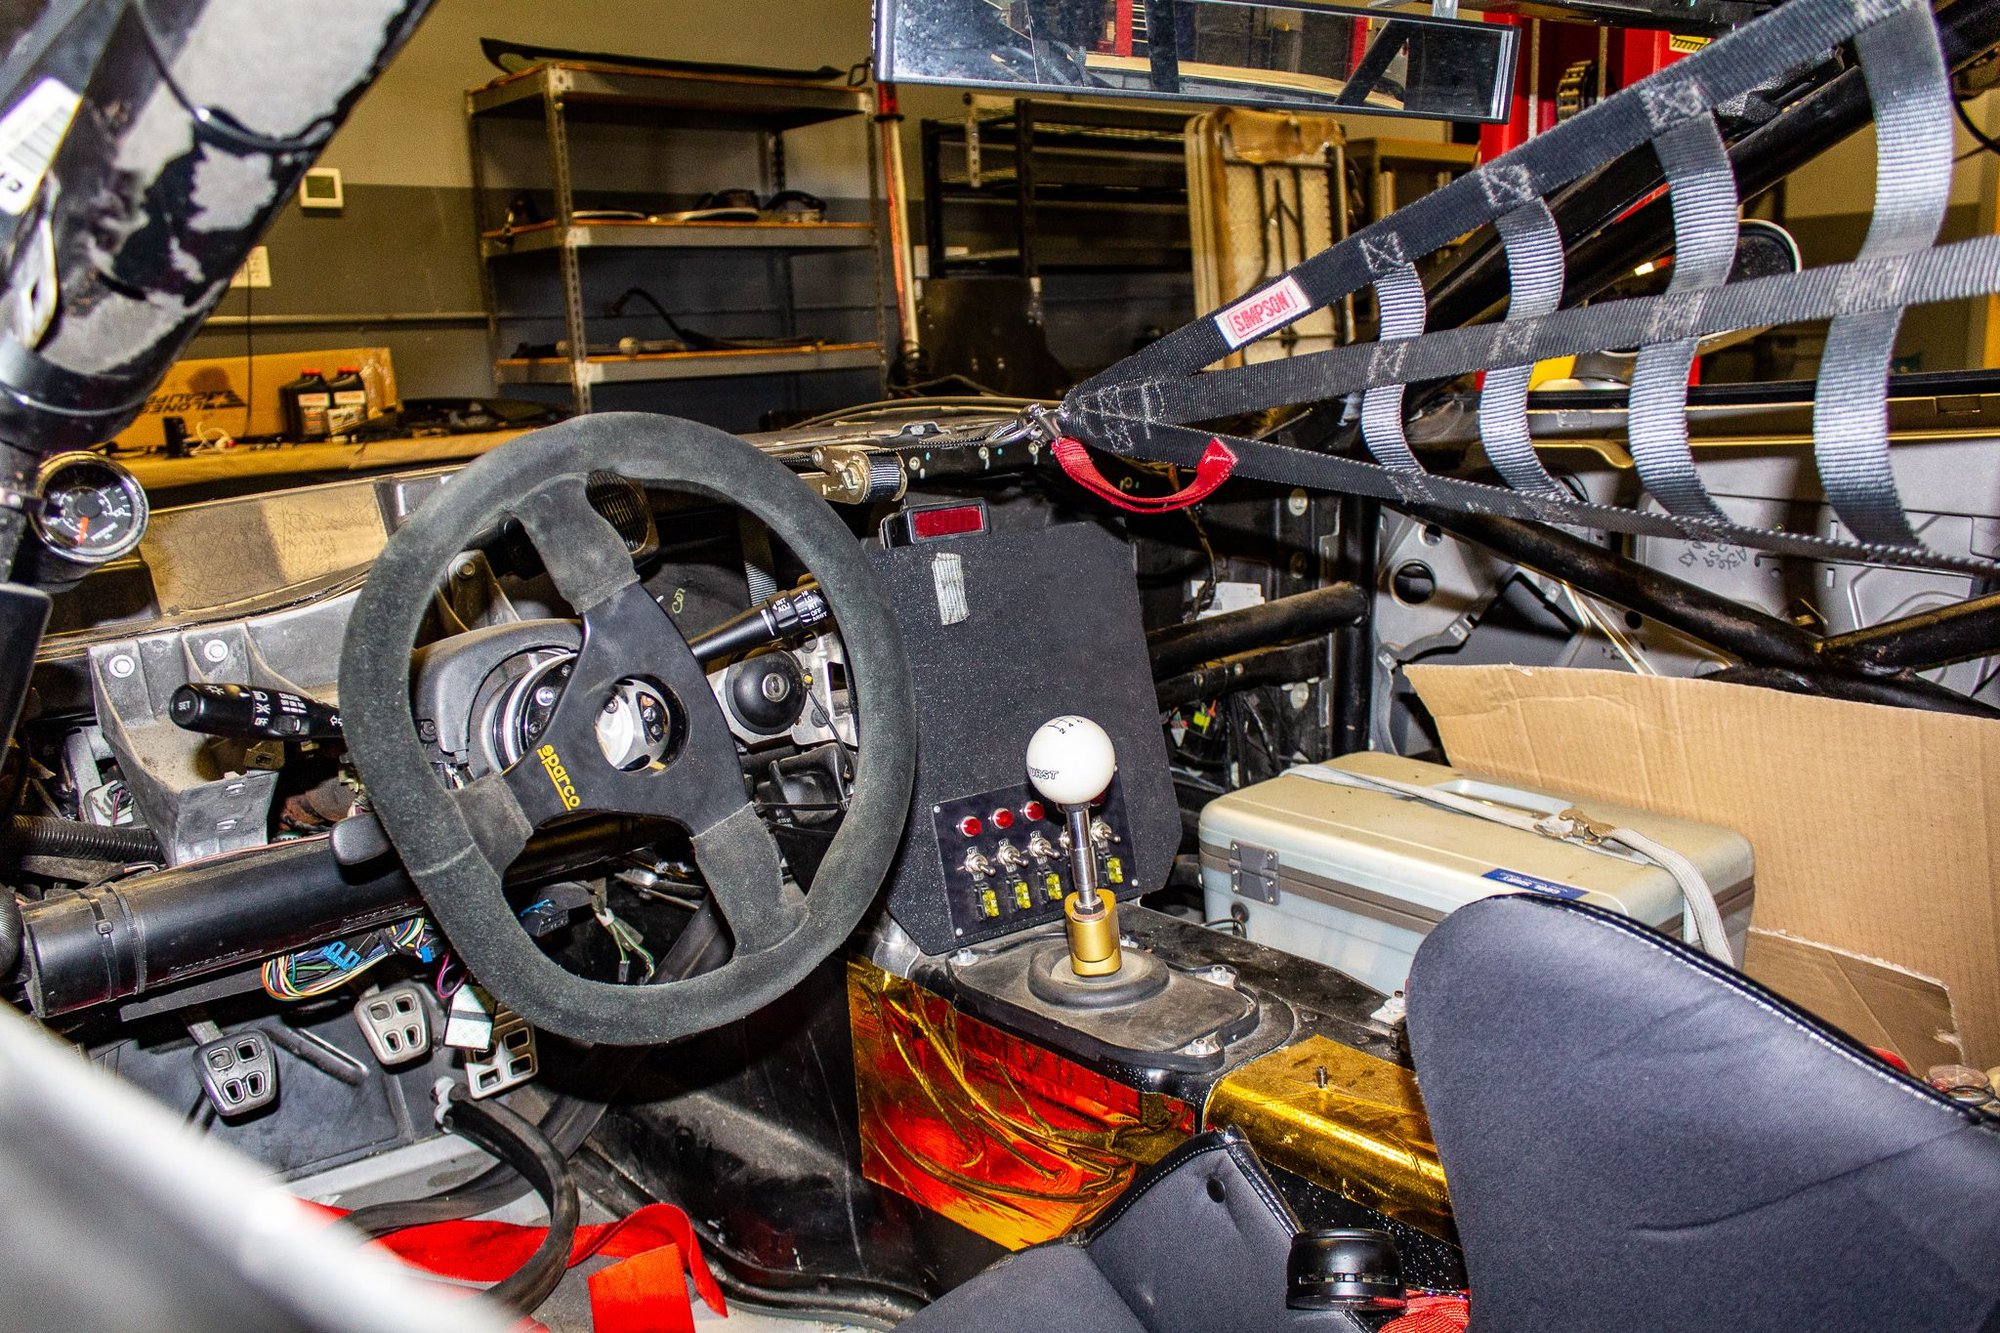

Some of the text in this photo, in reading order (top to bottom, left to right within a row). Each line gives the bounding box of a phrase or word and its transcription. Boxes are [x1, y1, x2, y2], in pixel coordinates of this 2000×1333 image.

[1233, 291, 1290, 332] SIMPSON
[804, 595, 813, 603] LO
[778, 603, 791, 612] ADJ
[810, 608, 822, 616] OFF
[178, 700, 191, 711] SET
[255, 717, 269, 727] OFF
[538, 744, 580, 809] sparco
[1028, 766, 1058, 780] URST
